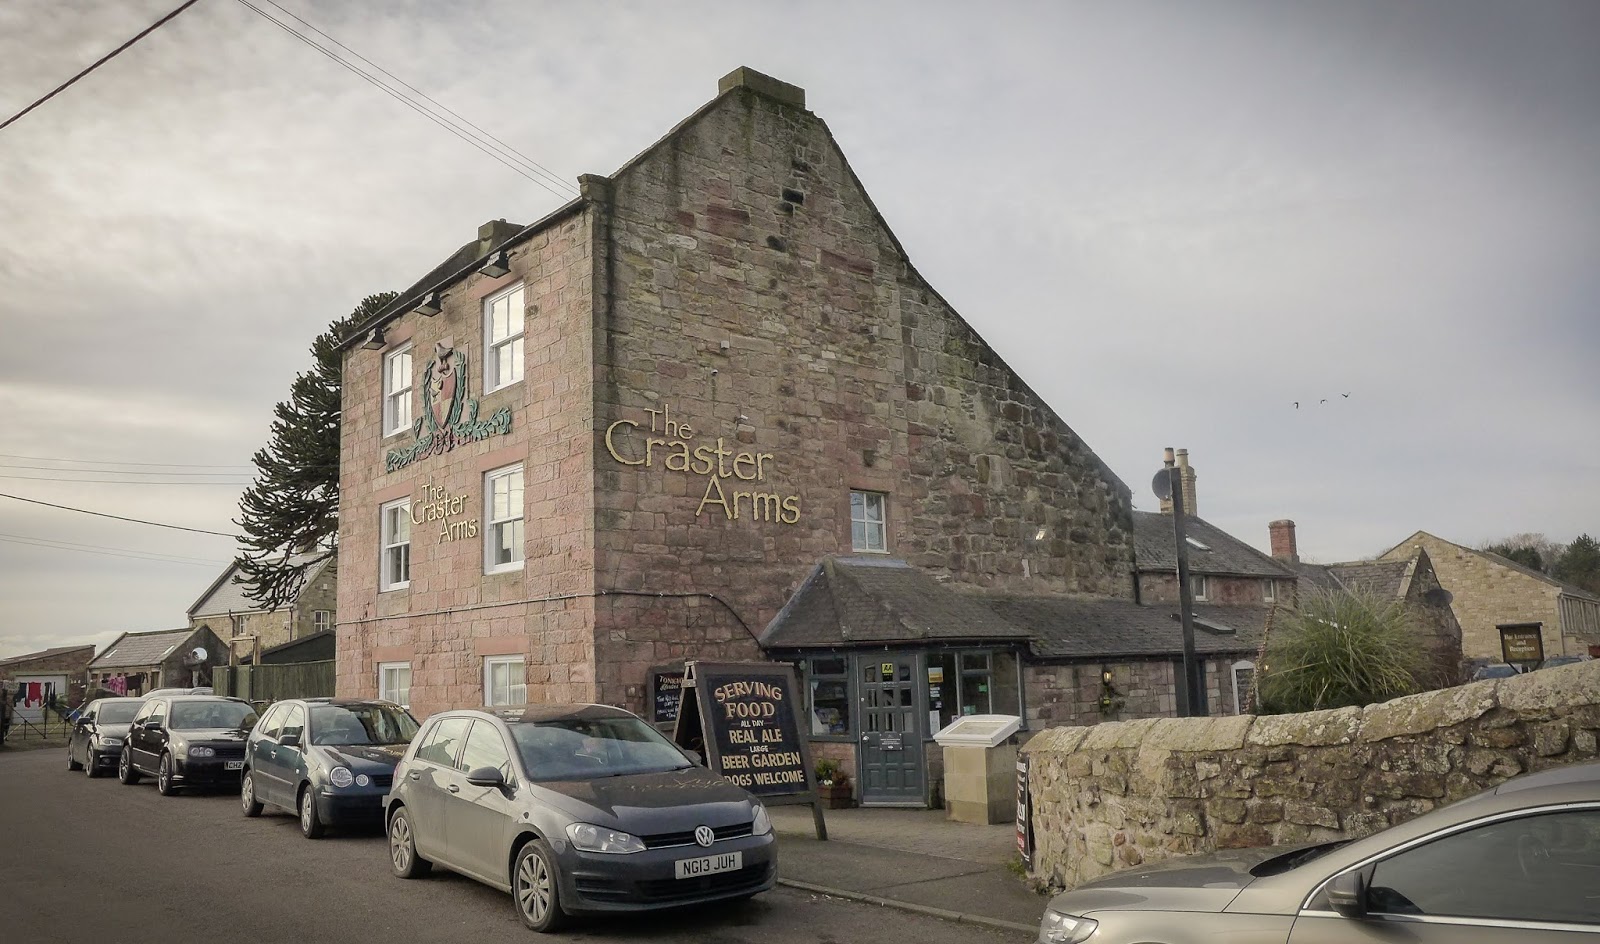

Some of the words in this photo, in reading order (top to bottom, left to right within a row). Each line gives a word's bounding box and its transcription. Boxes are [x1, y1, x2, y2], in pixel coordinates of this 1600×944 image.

[643, 403, 694, 439] The
[605, 419, 774, 480] Craster
[422, 475, 443, 503] The
[695, 473, 801, 524] Arms
[410, 491, 469, 525] Craster
[437, 517, 477, 545] Arms
[714, 681, 783, 702] SERVING
[725, 702, 775, 719] FOOD
[740, 720, 751, 728] ALL
[752, 719, 765, 728] DAY
[729, 730, 759, 744] REAL
[761, 728, 783, 743] ALE
[749, 745, 769, 753] LARGE
[721, 755, 750, 770] BEER
[751, 752, 801, 768] GARDEN
[754, 770, 805, 785] WELCOME
[683, 859, 710, 875] NG13
[713, 855, 735, 870] JUH
